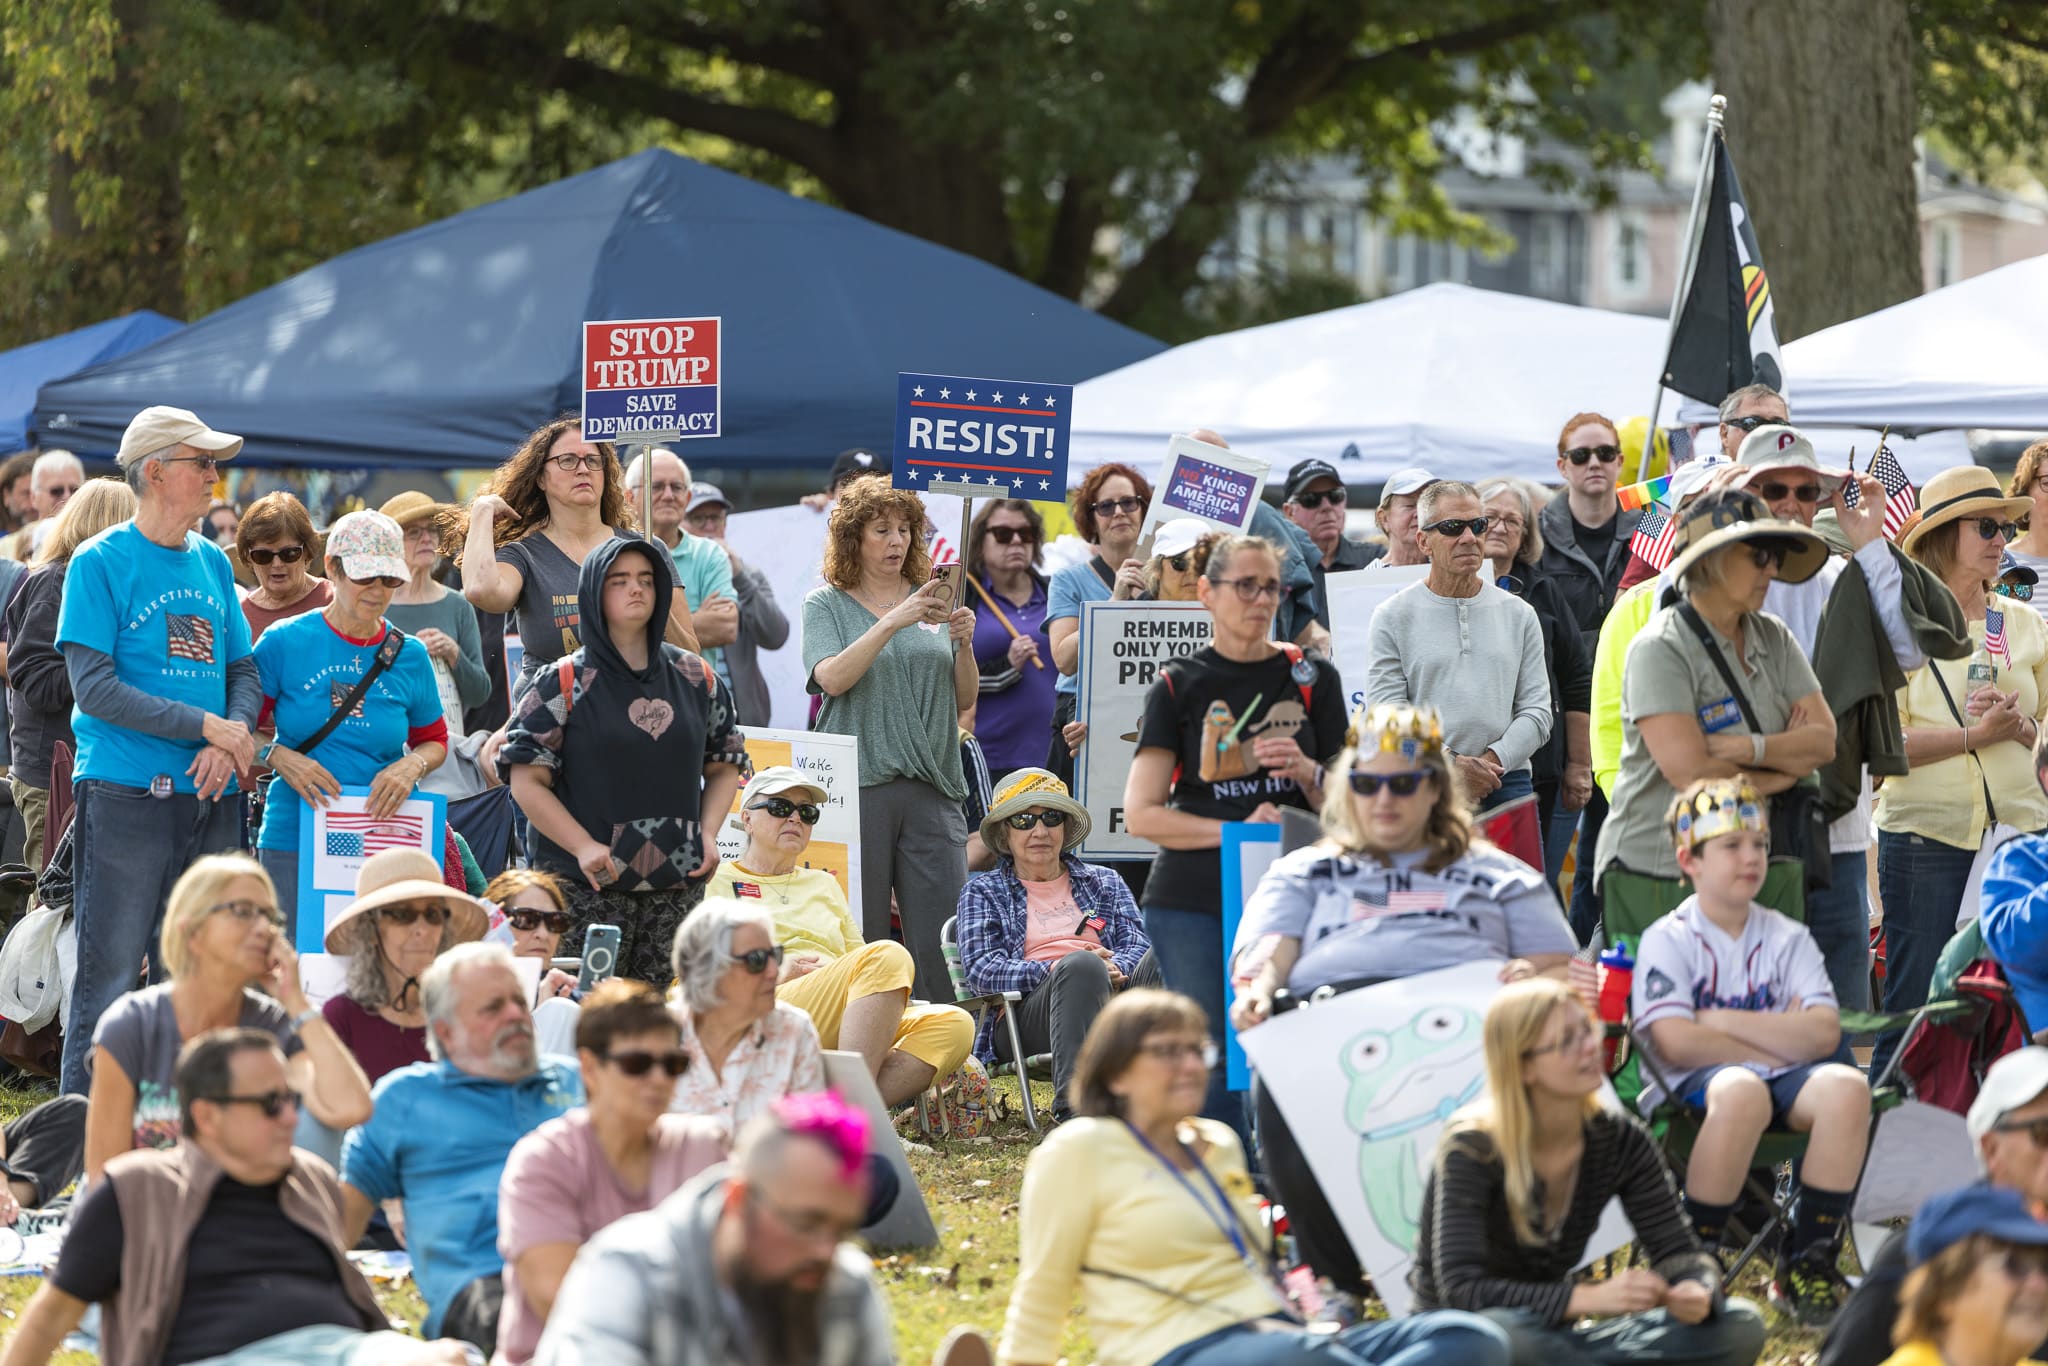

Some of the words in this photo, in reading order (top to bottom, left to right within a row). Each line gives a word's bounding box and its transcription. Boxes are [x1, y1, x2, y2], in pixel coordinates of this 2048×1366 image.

[609, 326, 695, 357] STOP
[593, 356, 711, 388] TRUMP
[626, 393, 677, 413] SAVE
[587, 412, 715, 435] DEMOCRACY
[908, 417, 1055, 459] RESIST!
[1178, 467, 1200, 482] NO
[1202, 474, 1247, 498] KINGS
[1172, 484, 1240, 515] AMERICA
[129, 588, 202, 631] REJECTING
[1112, 641, 1160, 658] ONLY
[161, 668, 197, 678] SINCE
[303, 663, 363, 691] REJECTING
[817, 774, 834, 789] up
[1213, 779, 1260, 801] NEW
